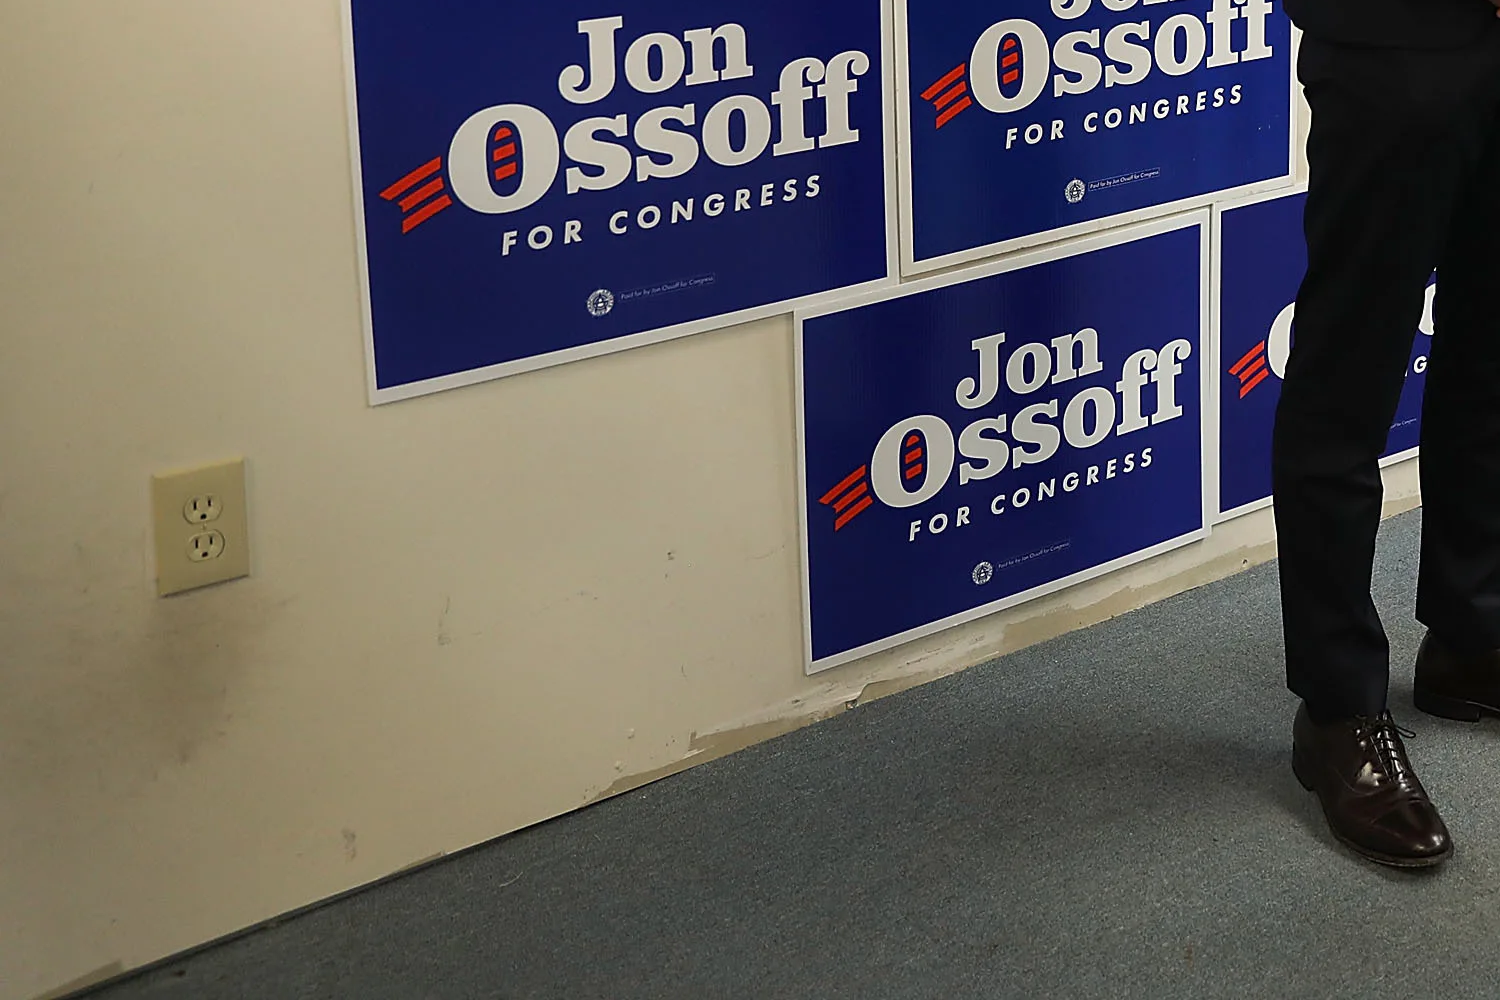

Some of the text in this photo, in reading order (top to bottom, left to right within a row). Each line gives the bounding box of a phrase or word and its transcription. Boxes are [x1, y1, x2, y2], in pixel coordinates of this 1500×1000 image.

[558, 15, 754, 104] Jon
[447, 50, 870, 215] Ossoff
[1005, 84, 1244, 150] FOR CONGRESS
[501, 174, 822, 256] FOR CONGRESS
[955, 327, 1103, 409] Jon
[870, 338, 1191, 508] Ossoff
[908, 447, 1154, 542] FOR CONGRESS
